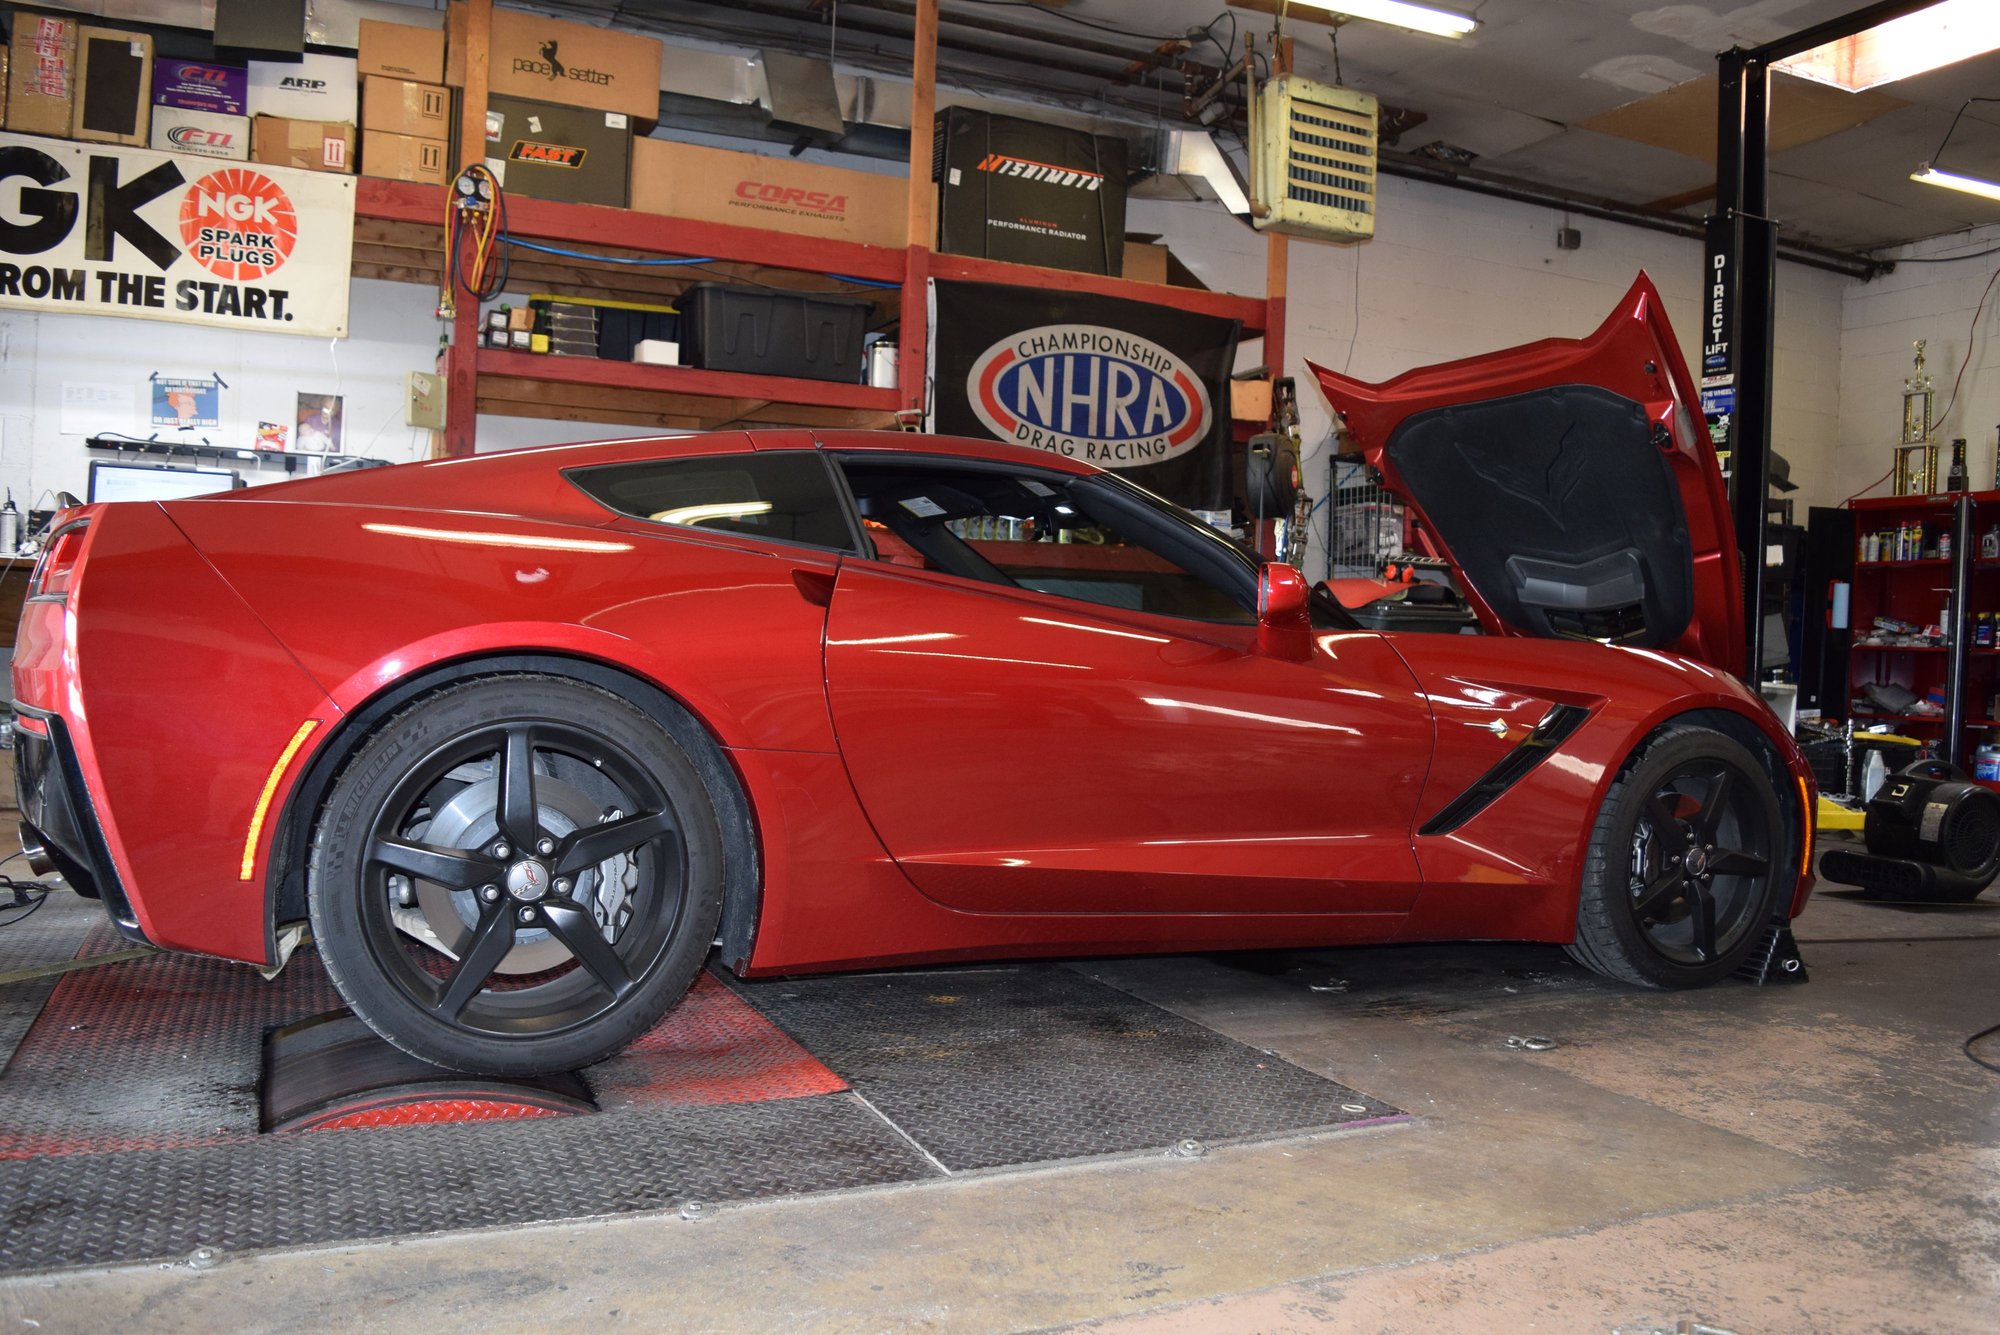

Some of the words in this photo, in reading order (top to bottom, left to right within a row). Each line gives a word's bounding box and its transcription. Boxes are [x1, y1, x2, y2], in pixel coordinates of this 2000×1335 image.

[280, 76, 326, 89] ARP
[512, 58, 551, 75] pace
[568, 67, 615, 86] setter
[181, 127, 233, 147] FTI
[520, 144, 575, 163] FAST
[976, 153, 1104, 191] MISHIMOTO
[198, 191, 279, 225] NGK
[728, 199, 798, 215] PERFORMANCE
[798, 210, 846, 222] EXHAUSTS
[735, 180, 849, 213] CORSA
[987, 219, 1047, 235] PERFORMANCE
[1048, 228, 1087, 241] RADIATOR
[1019, 217, 1058, 228] ALUMINUM
[200, 228, 275, 249] SPARK
[200, 245, 275, 266] PLUGS
[96, 270, 166, 307] THE
[175, 279, 294, 322] START.
[1712, 254, 1725, 342] DIRECT
[1018, 331, 1172, 375] CHAMPIONSHIP
[1705, 342, 1728, 355] LIFT
[1016, 353, 1172, 438] NHRA
[1015, 422, 1075, 457] DRAG
[1086, 437, 1167, 461] RACING
[343, 741, 402, 818] MICHELIN
[609, 856, 618, 908] ORVETTE
